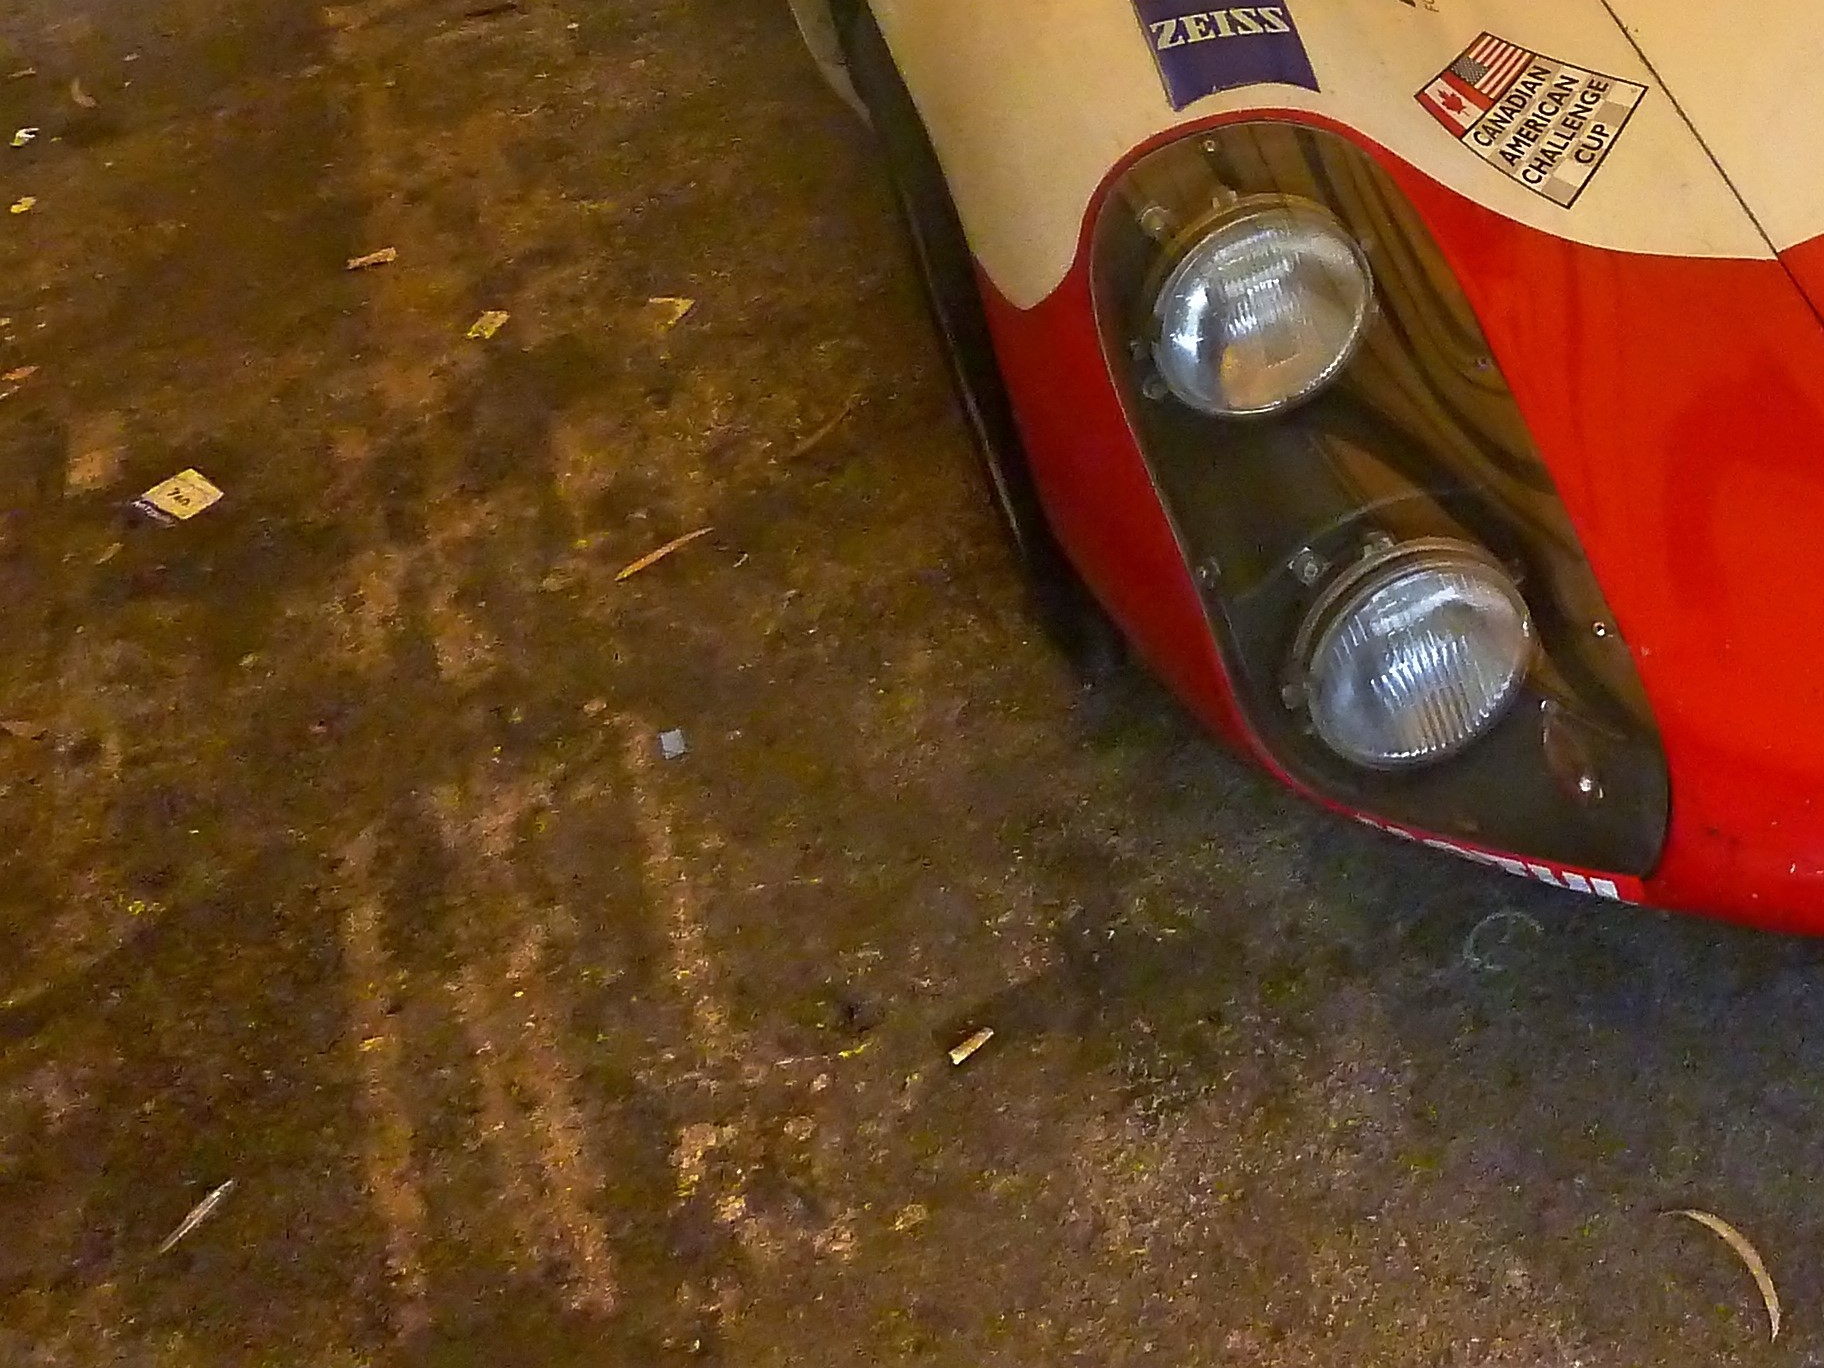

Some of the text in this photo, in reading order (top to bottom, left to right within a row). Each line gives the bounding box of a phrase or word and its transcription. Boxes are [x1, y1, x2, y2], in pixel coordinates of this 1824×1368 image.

[1149, 6, 1290, 51] ZEISS
[1473, 65, 1552, 147] CANADIAN
[1499, 74, 1580, 167] AMERICAN
[1522, 78, 1609, 185] CHALLENGE
[1573, 123, 1611, 165] CUP
